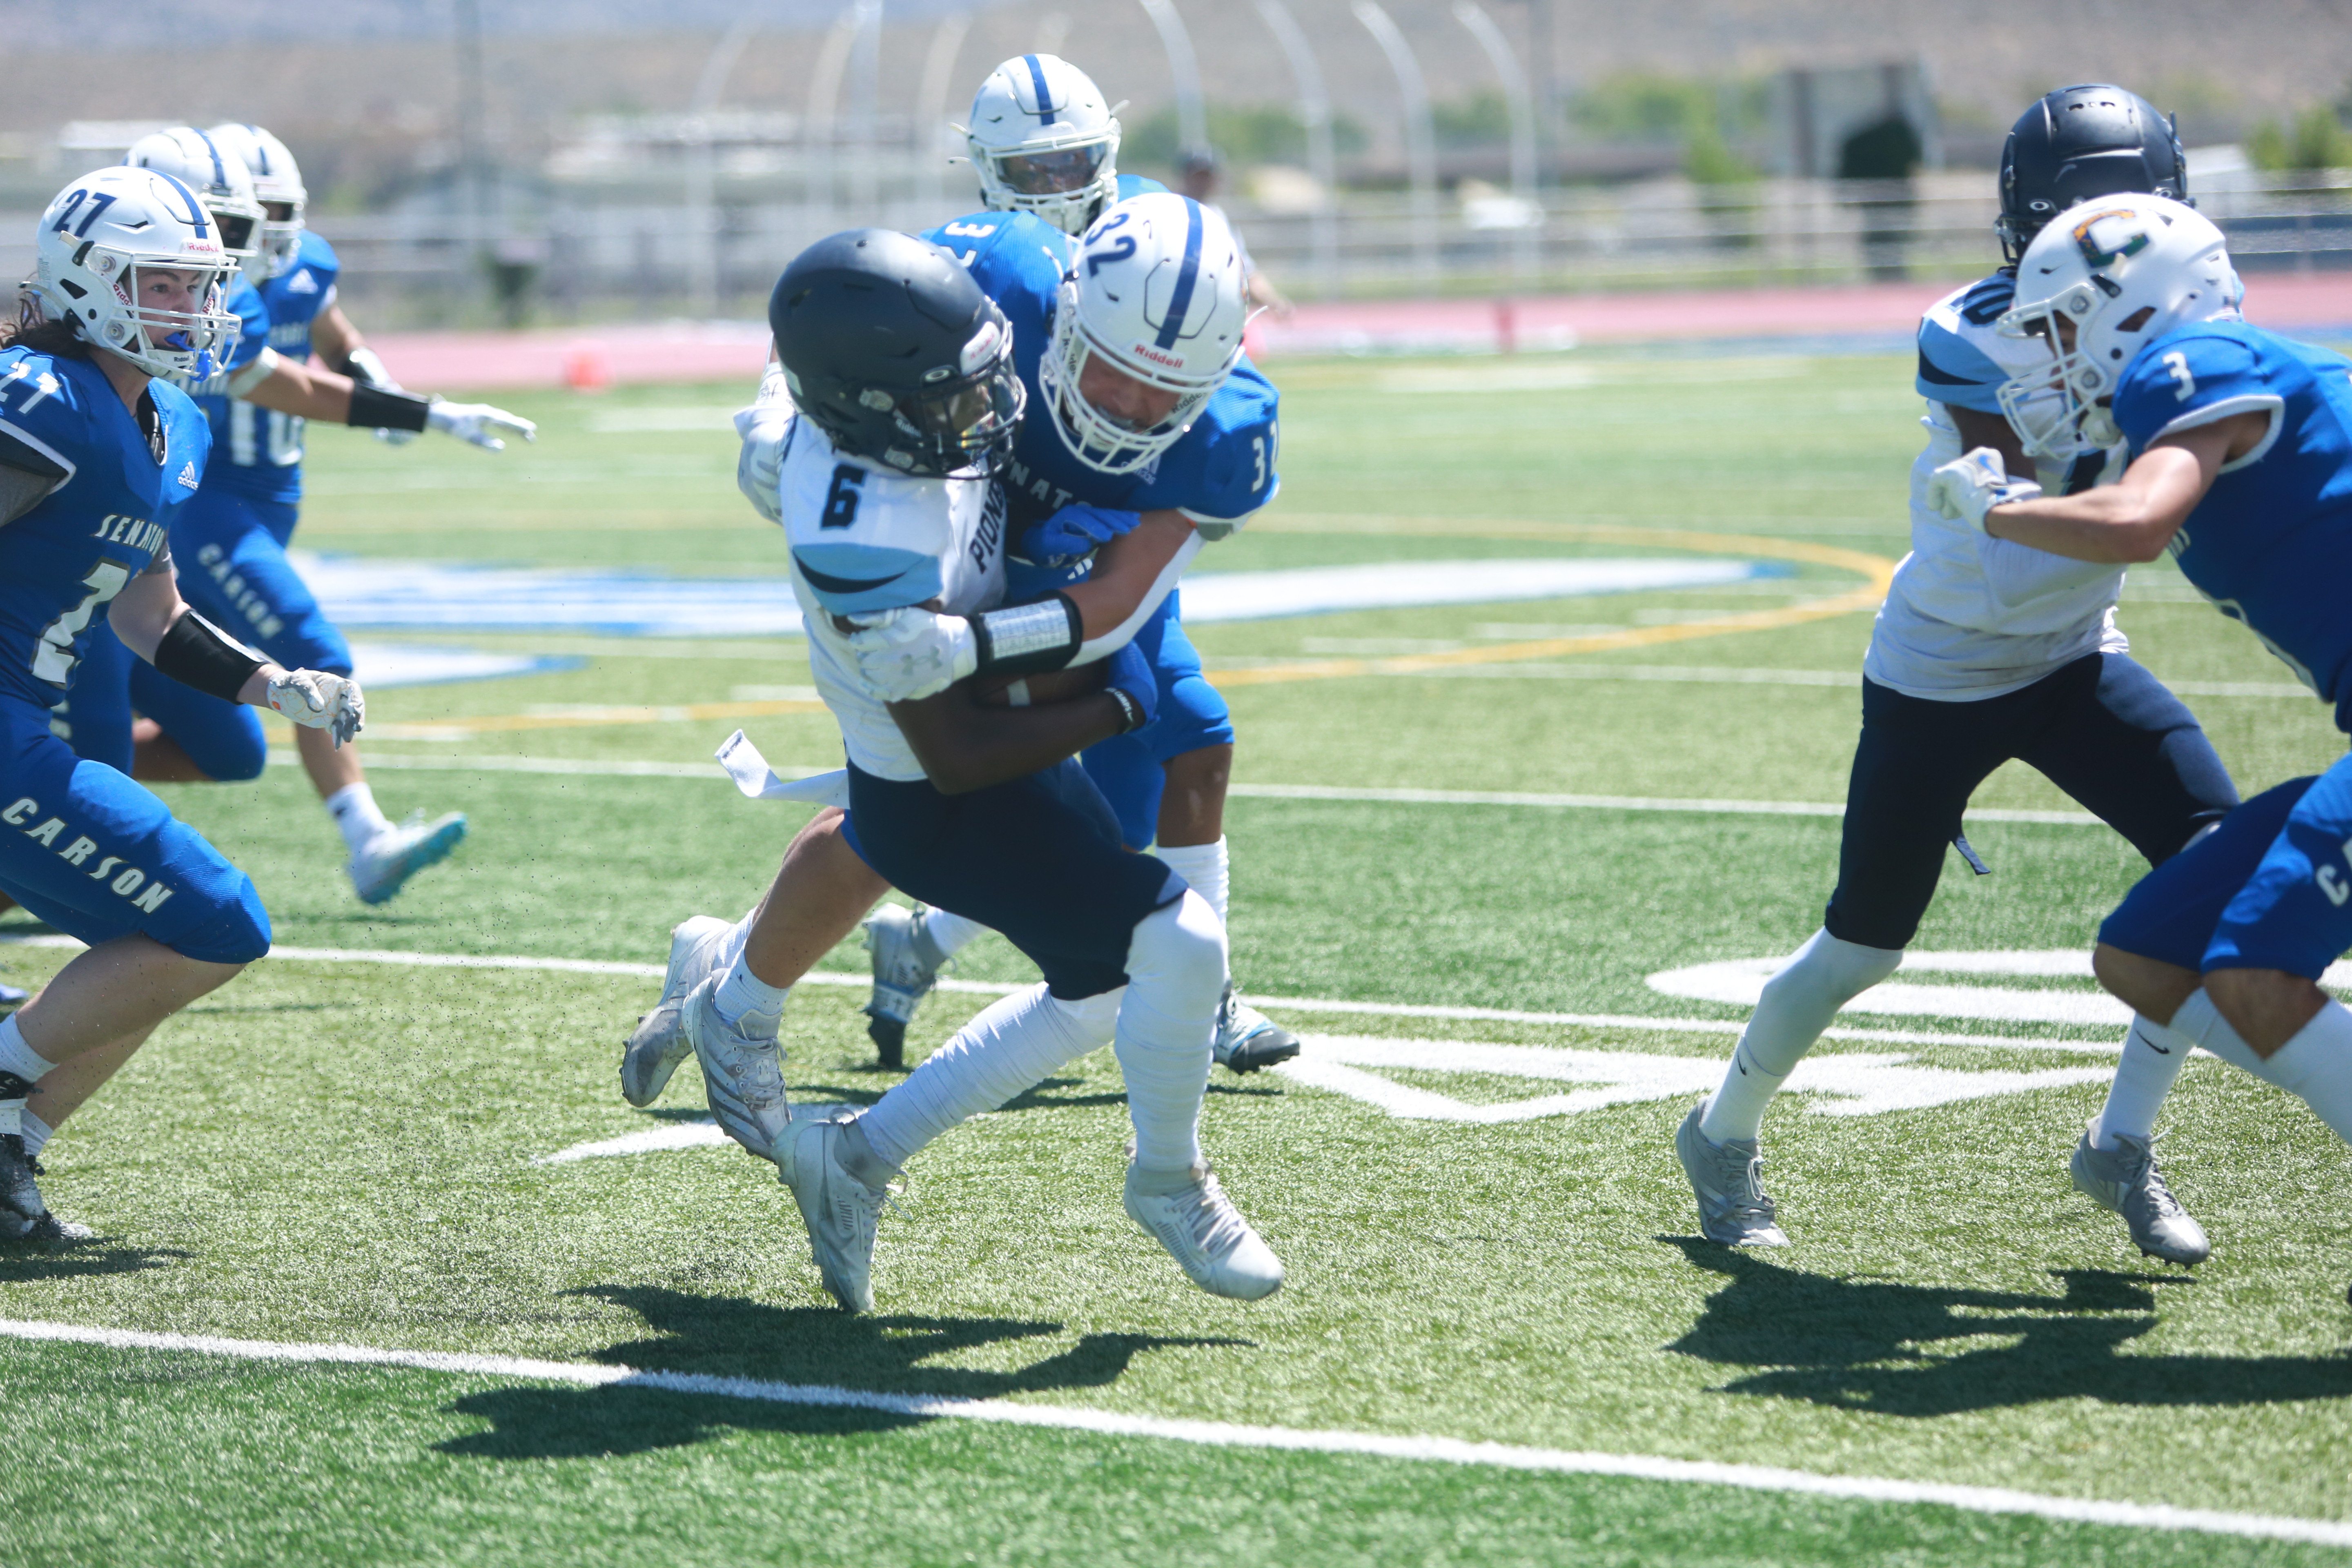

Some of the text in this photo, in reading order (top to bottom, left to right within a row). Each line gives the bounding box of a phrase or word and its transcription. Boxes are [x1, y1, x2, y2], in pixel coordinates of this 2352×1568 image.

[52, 189, 117, 238] 27
[1085, 214, 1137, 279] 32
[113, 284, 134, 314] Ridd
[1134, 344, 1183, 369] Riddell
[2162, 352, 2195, 401] 3
[0, 361, 62, 416] 27
[820, 463, 867, 531] 6
[2, 797, 176, 915] CARSON
